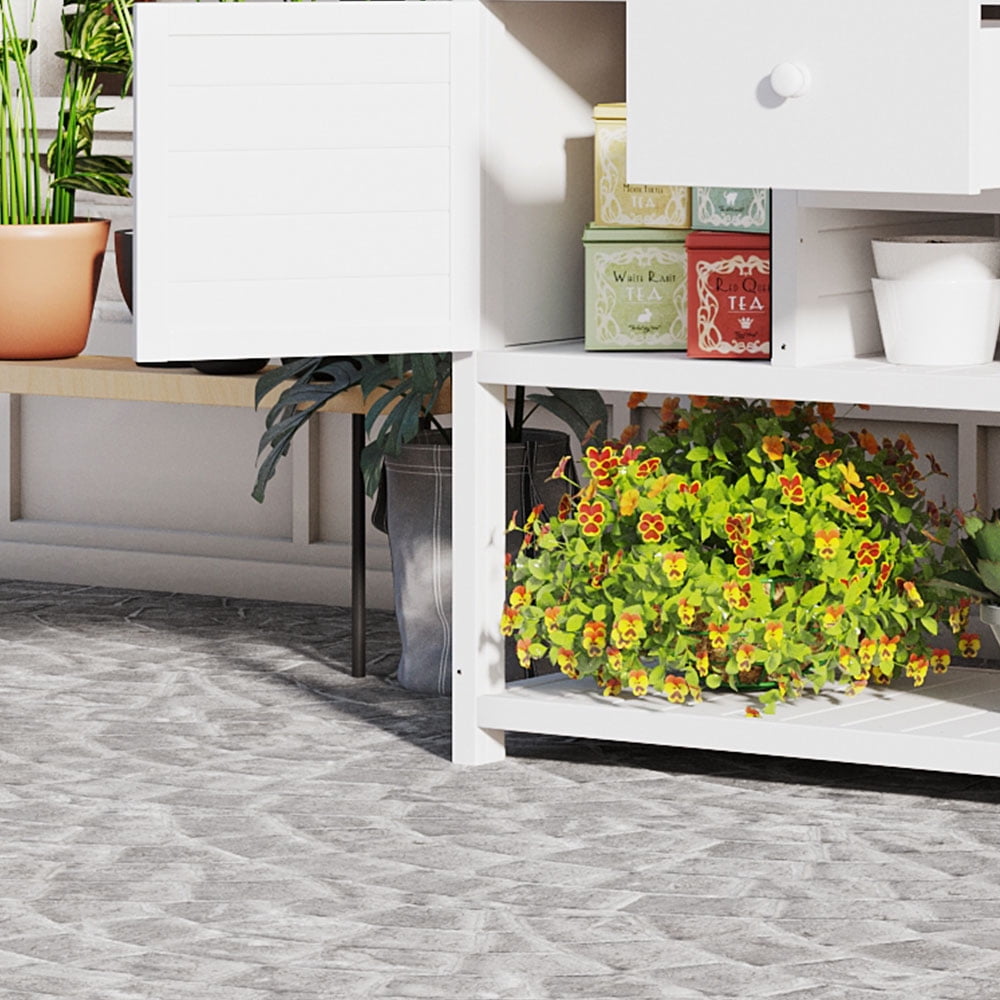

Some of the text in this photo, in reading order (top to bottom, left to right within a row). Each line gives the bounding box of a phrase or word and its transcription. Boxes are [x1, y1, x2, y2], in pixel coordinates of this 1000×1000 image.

[631, 195, 656, 209] TEA
[626, 287, 663, 301] TEA
[728, 295, 765, 311] TEA
